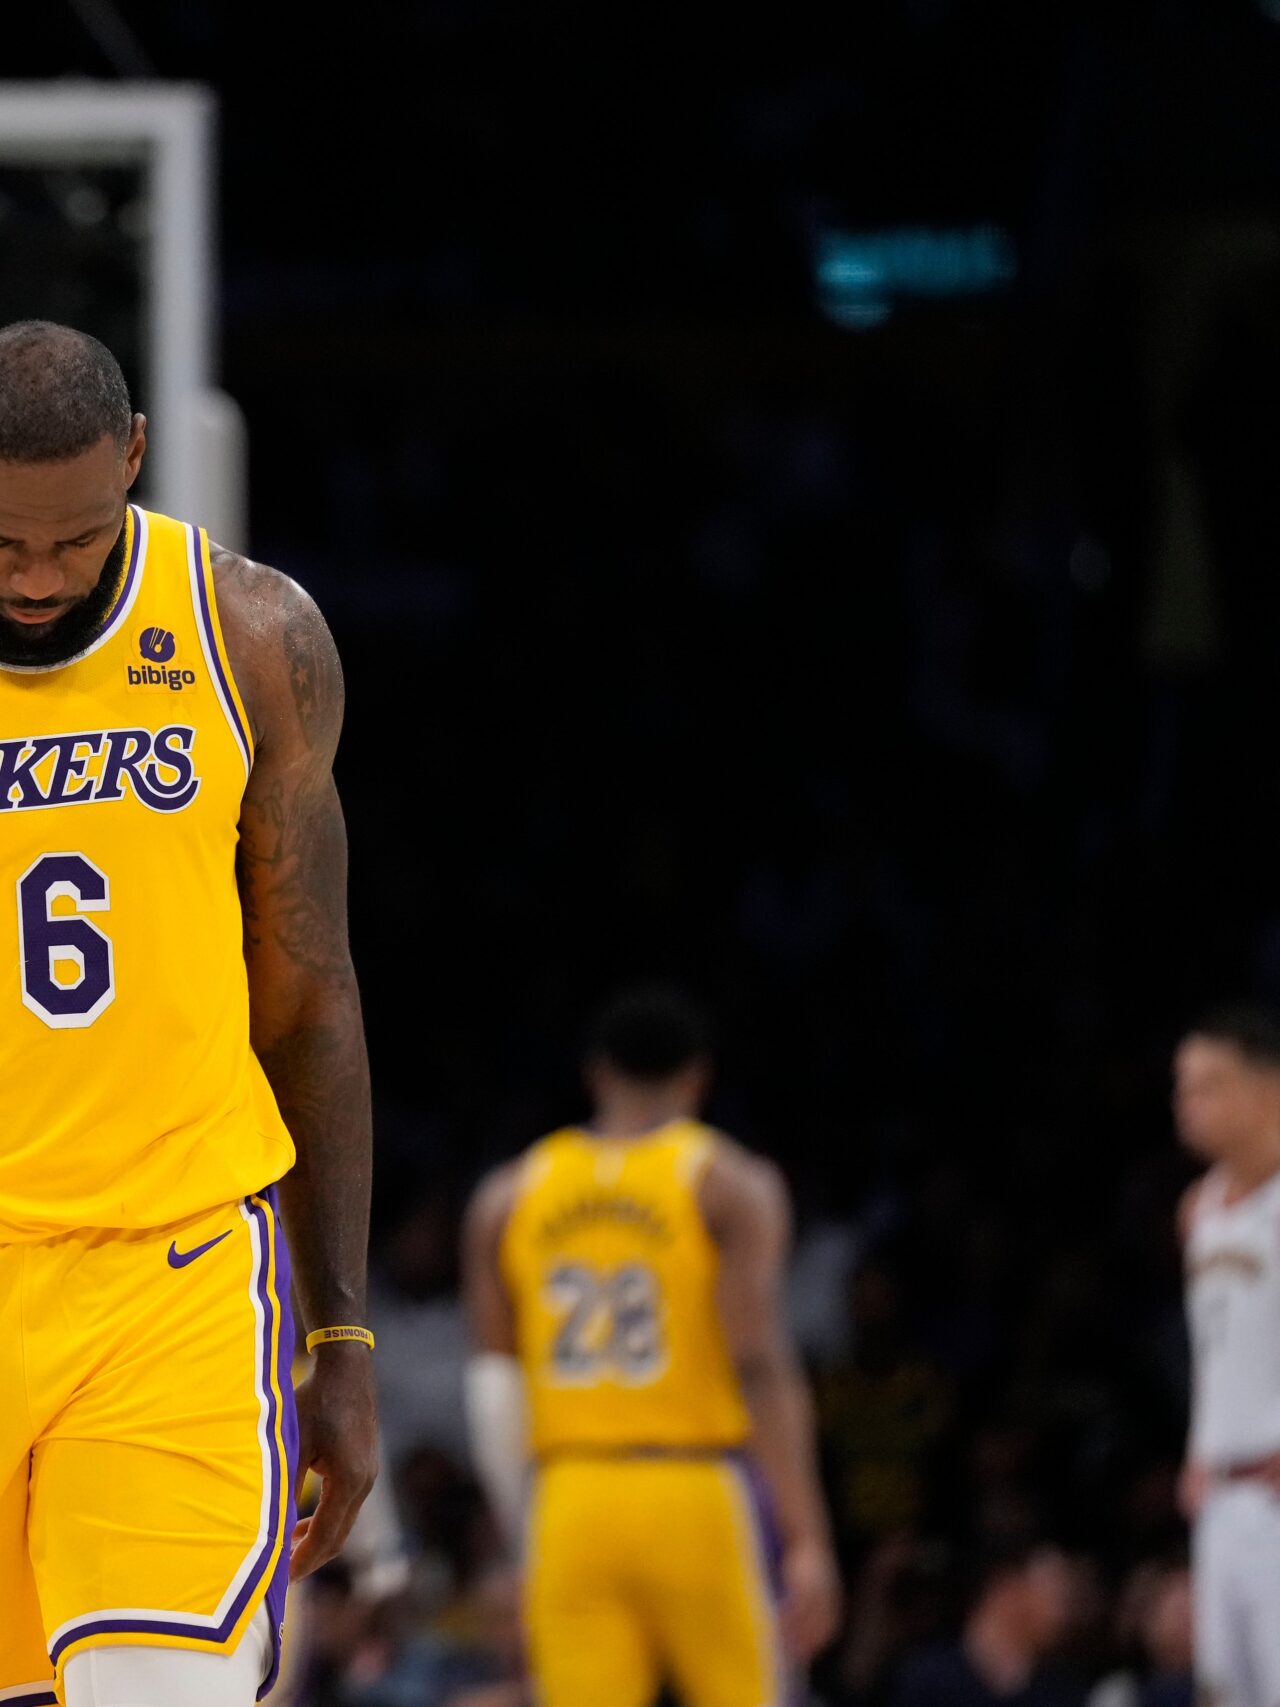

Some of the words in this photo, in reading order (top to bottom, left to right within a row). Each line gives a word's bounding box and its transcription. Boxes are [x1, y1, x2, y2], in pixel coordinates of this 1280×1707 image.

[127, 665, 196, 691] bibigo
[16, 851, 116, 1029] 6
[324, 1329, 368, 1340] PROMISE
[540, 1258, 668, 1388] 28
